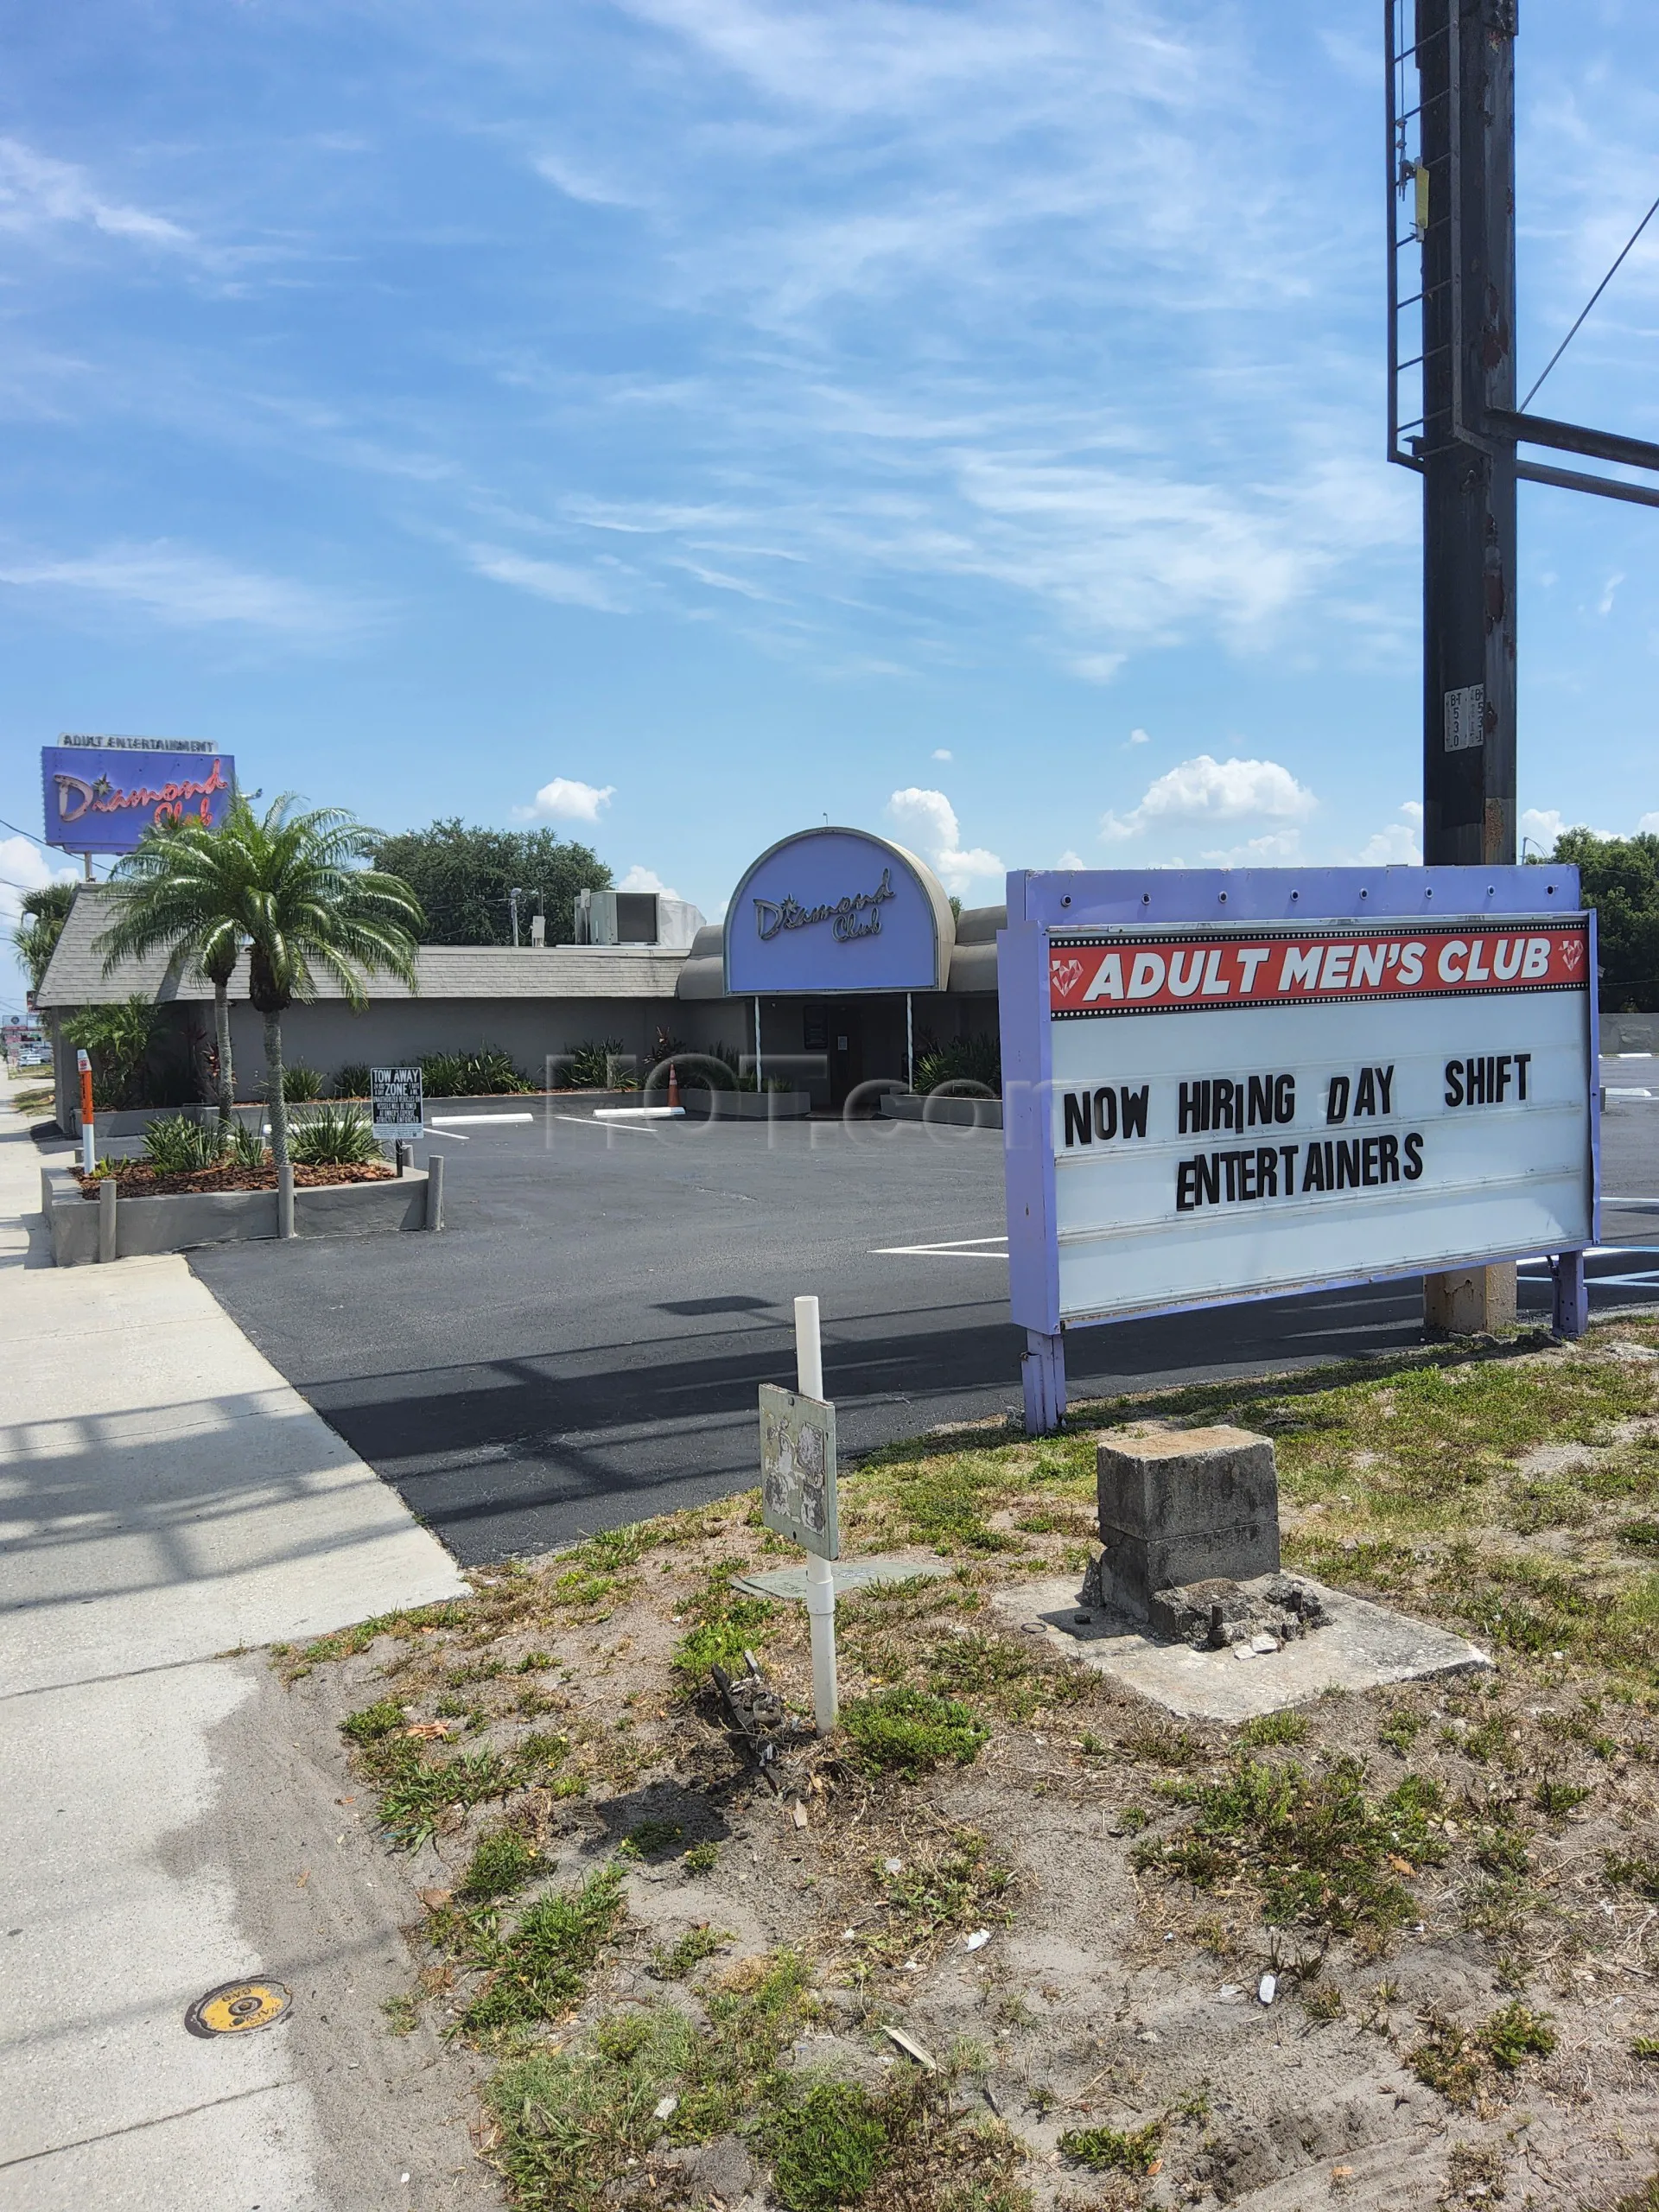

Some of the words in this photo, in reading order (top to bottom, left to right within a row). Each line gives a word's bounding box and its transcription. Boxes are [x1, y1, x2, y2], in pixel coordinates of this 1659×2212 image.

[54, 757, 228, 822] Diamond
[753, 868, 896, 941] Diamond
[832, 908, 882, 943] Club
[1082, 947, 1271, 1002] ADULT
[1277, 941, 1427, 992] MEN'S
[1437, 938, 1552, 984] CLUB
[373, 1070, 391, 1083] TOW
[394, 1070, 418, 1083] AWAY
[385, 1083, 409, 1096] ZONE
[1064, 1084, 1149, 1147] NOW
[1178, 1073, 1295, 1135] HIRING
[1326, 1065, 1395, 1125] DAY
[1445, 1053, 1531, 1108] SHIFT
[1176, 1132, 1424, 1211] ENTERTAINERS
